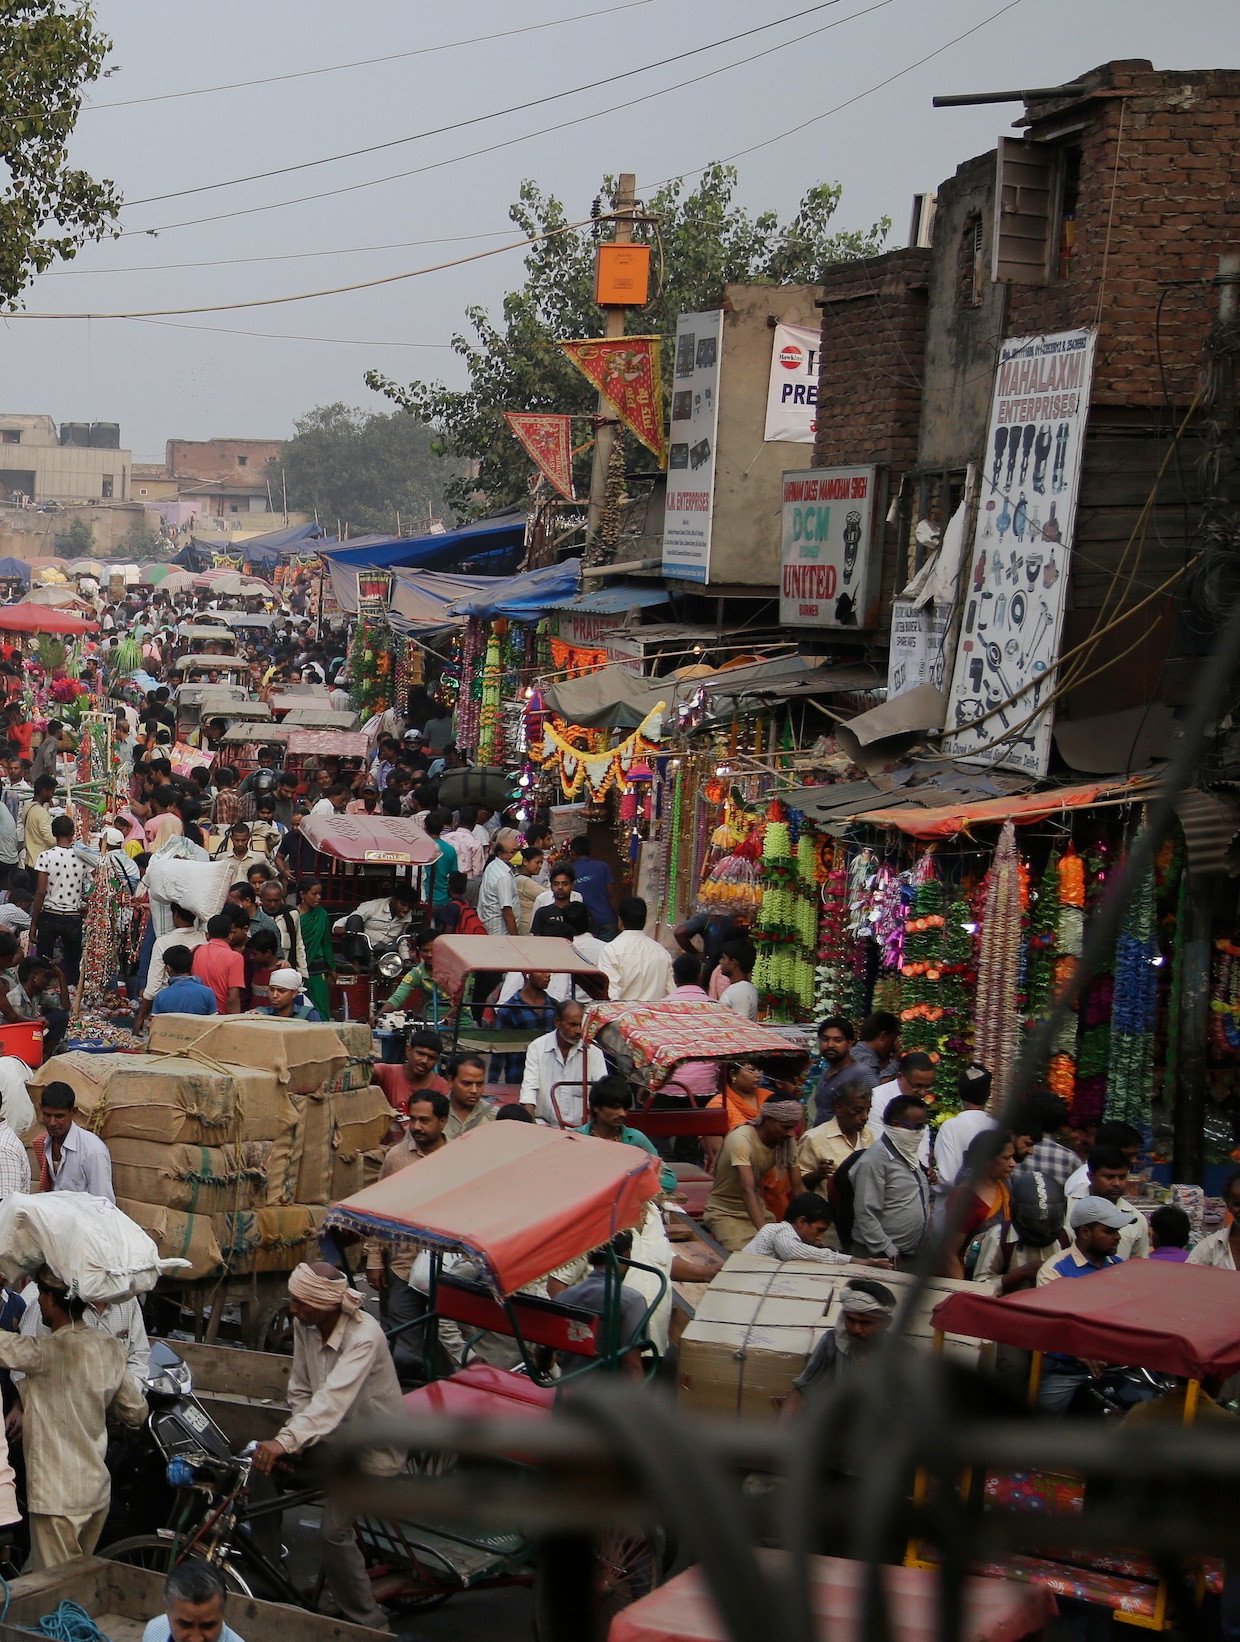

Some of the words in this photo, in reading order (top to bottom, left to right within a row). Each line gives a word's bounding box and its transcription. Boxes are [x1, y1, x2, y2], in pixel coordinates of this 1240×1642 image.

[779, 353, 803, 361] Hawkins
[998, 351, 1087, 396] MAHALAXMI
[998, 393, 1077, 423] ENTERPRISES
[850, 477, 868, 499] SINGH
[793, 506, 831, 541] DCM
[783, 565, 837, 600] UNITED
[799, 604, 818, 616] BURNER
